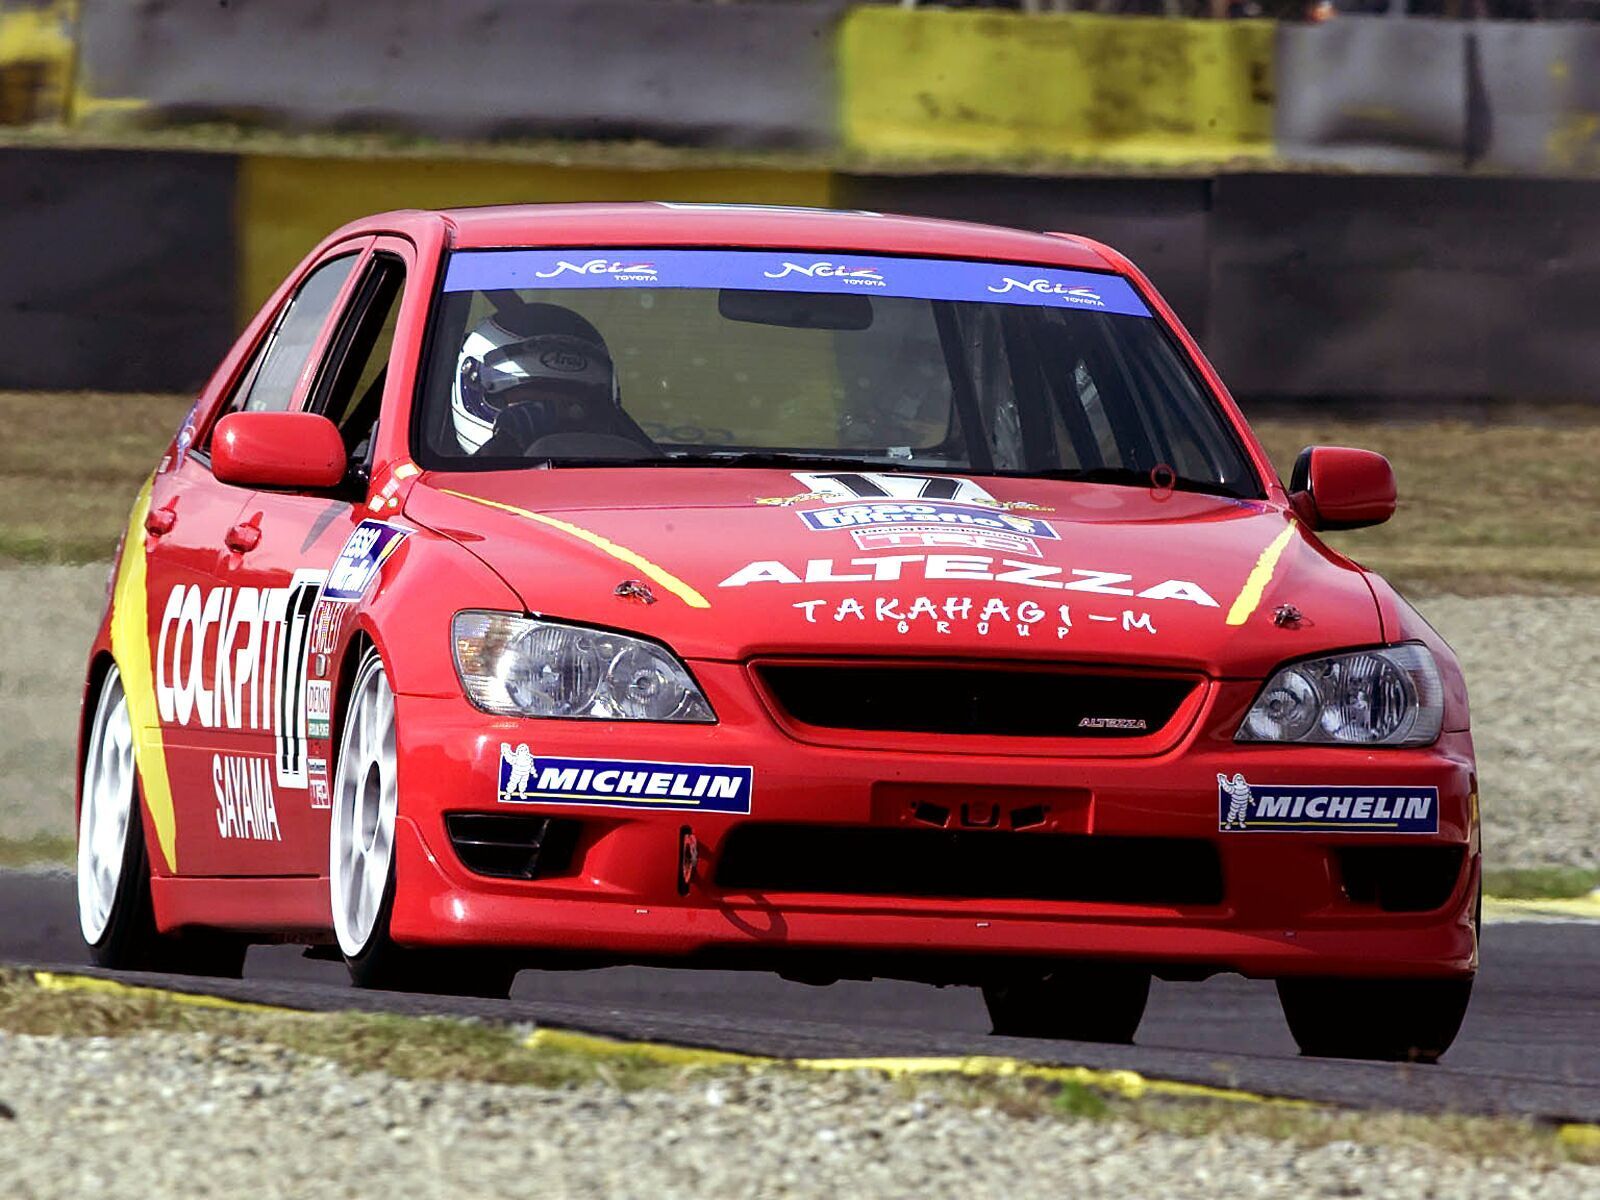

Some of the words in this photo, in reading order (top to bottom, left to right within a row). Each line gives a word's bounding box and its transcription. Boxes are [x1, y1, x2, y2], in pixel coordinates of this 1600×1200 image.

[613, 274, 659, 282] TOYOTA
[843, 278, 887, 287] TOYOTA
[1063, 296, 1105, 307] TOYOTA
[811, 473, 964, 499] 17
[718, 555, 1220, 608] ALTEZZA
[897, 621, 1070, 640] GROUP
[157, 583, 290, 730] COCKPIT
[308, 686, 330, 713] DENSO
[1078, 717, 1147, 730] ALTEZZA
[536, 767, 743, 799] MICHELIN
[213, 753, 282, 841] SAYAMA
[1255, 796, 1432, 820] MICHELIN
